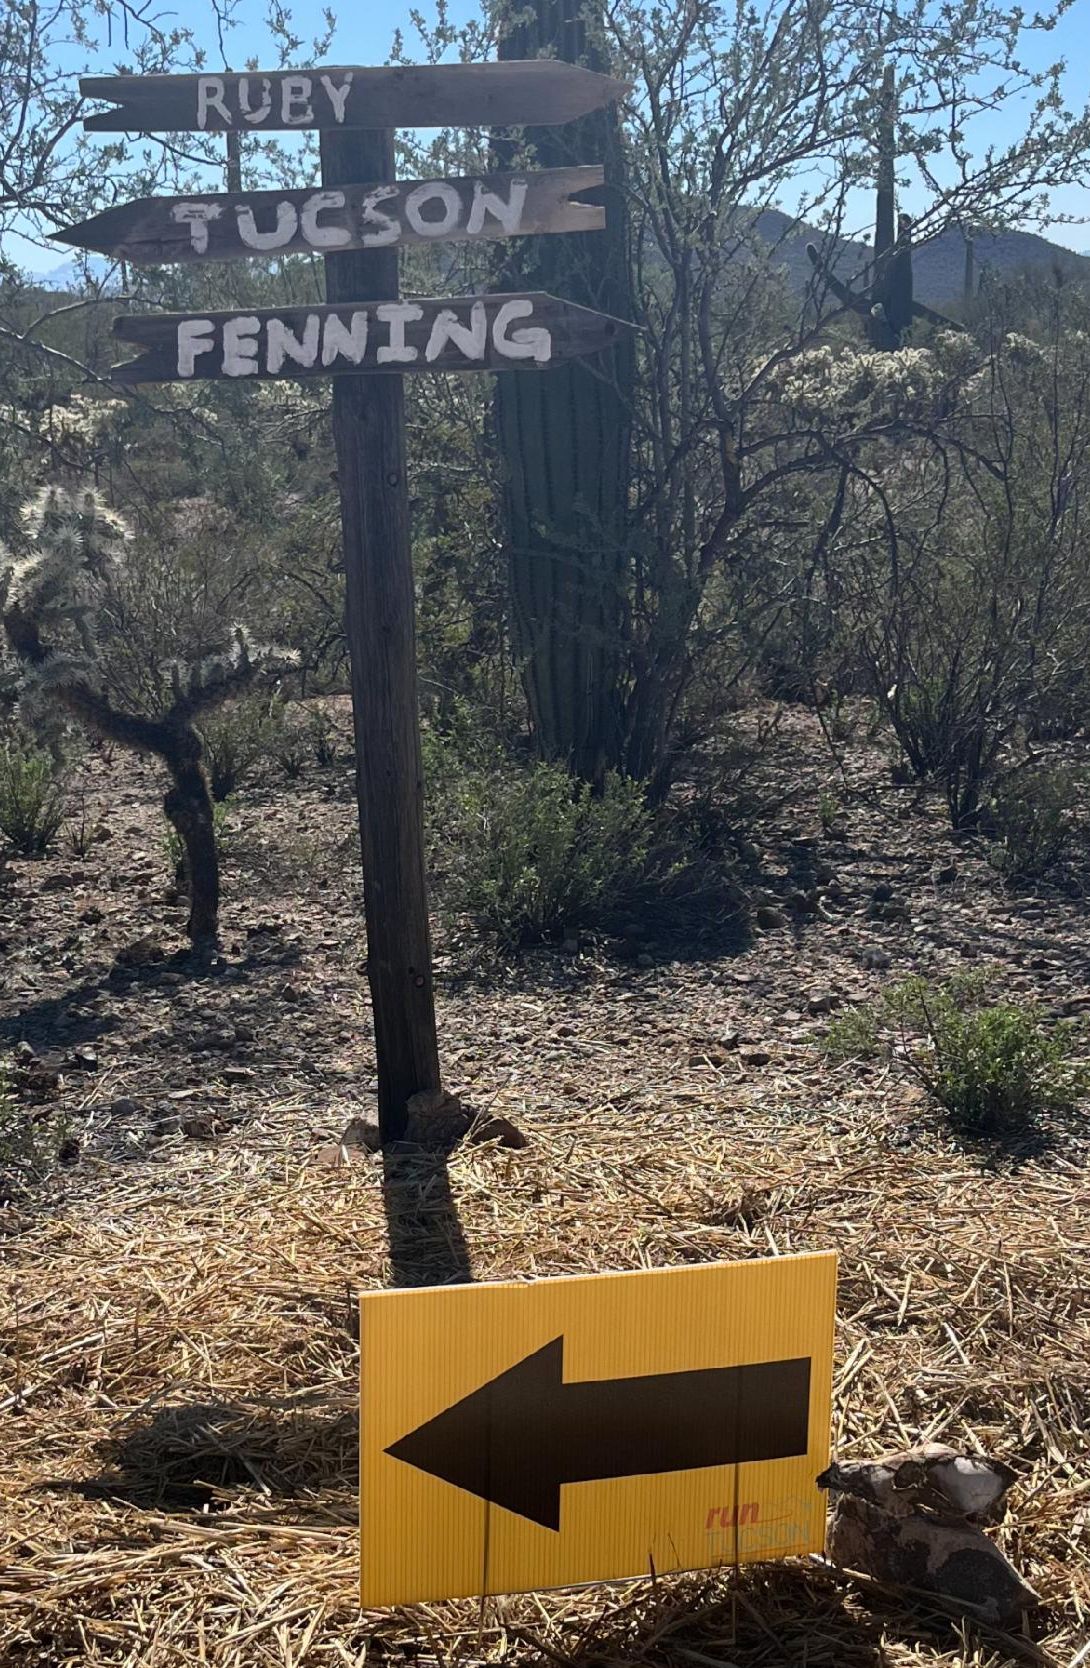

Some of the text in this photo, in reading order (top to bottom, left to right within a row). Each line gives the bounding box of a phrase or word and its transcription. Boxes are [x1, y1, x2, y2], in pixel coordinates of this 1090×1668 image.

[196, 72, 354, 129] RUBY
[171, 178, 528, 254] TUCSON
[176, 300, 552, 378] FENNING
[704, 1502, 760, 1529] run
